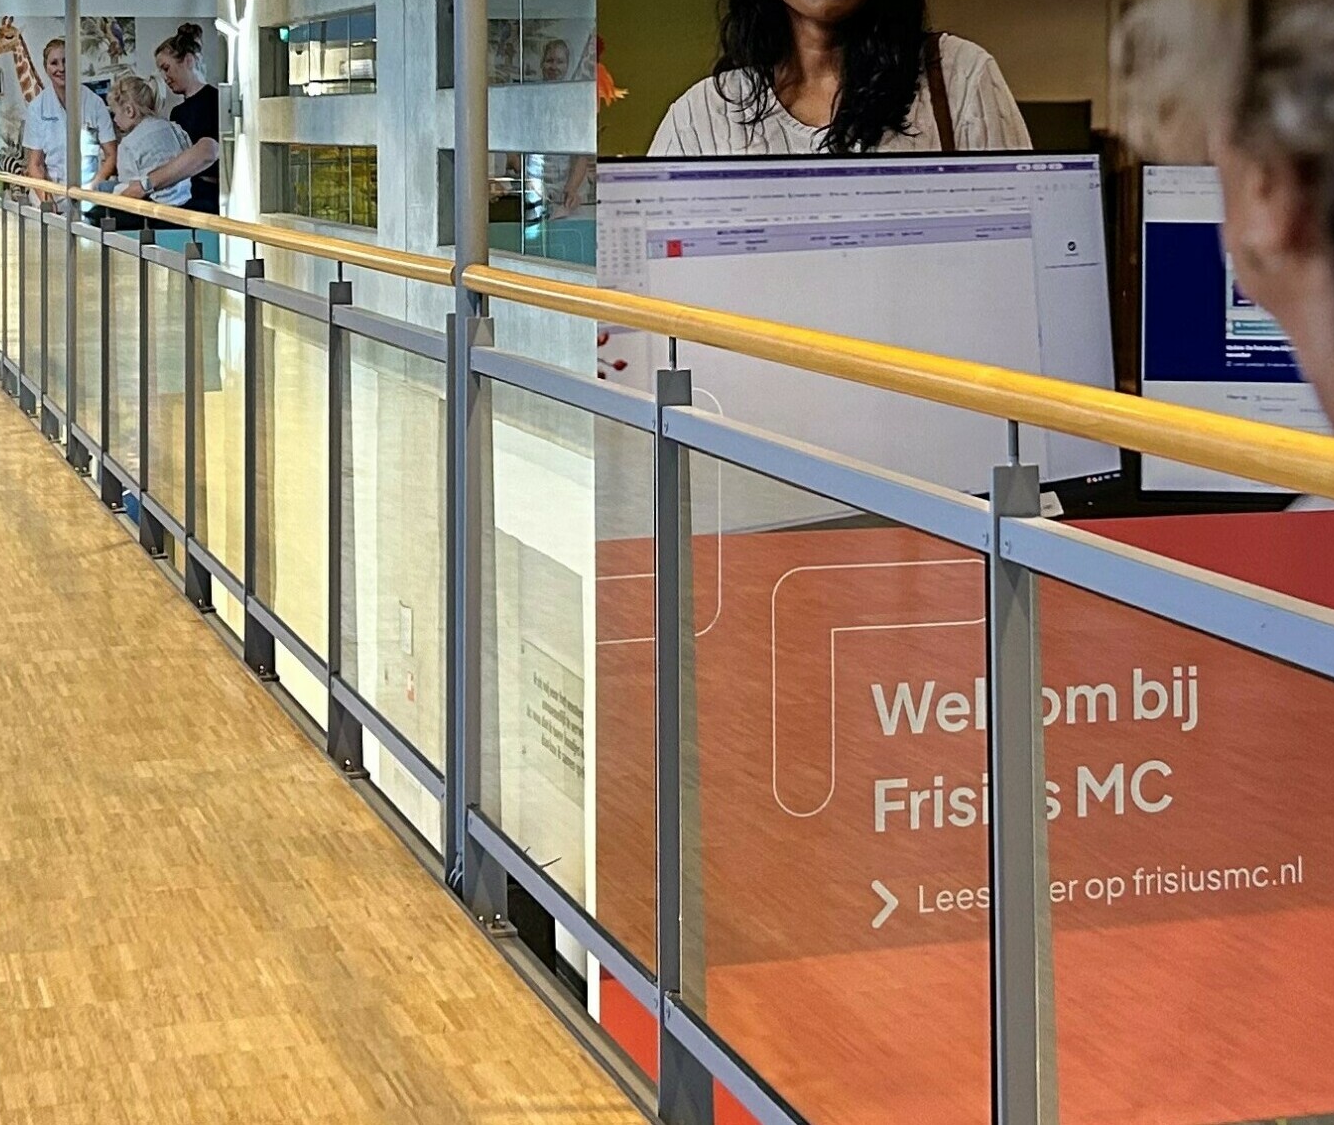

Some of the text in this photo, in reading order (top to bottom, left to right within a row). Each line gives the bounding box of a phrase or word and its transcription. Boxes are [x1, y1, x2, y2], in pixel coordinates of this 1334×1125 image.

[870, 665, 1198, 736] Welom bij
[874, 760, 1173, 832] Frisis MC
[918, 885, 990, 913] Lees
[1085, 877, 1125, 905] op
[1132, 855, 1303, 896] frisiusmc.nl
